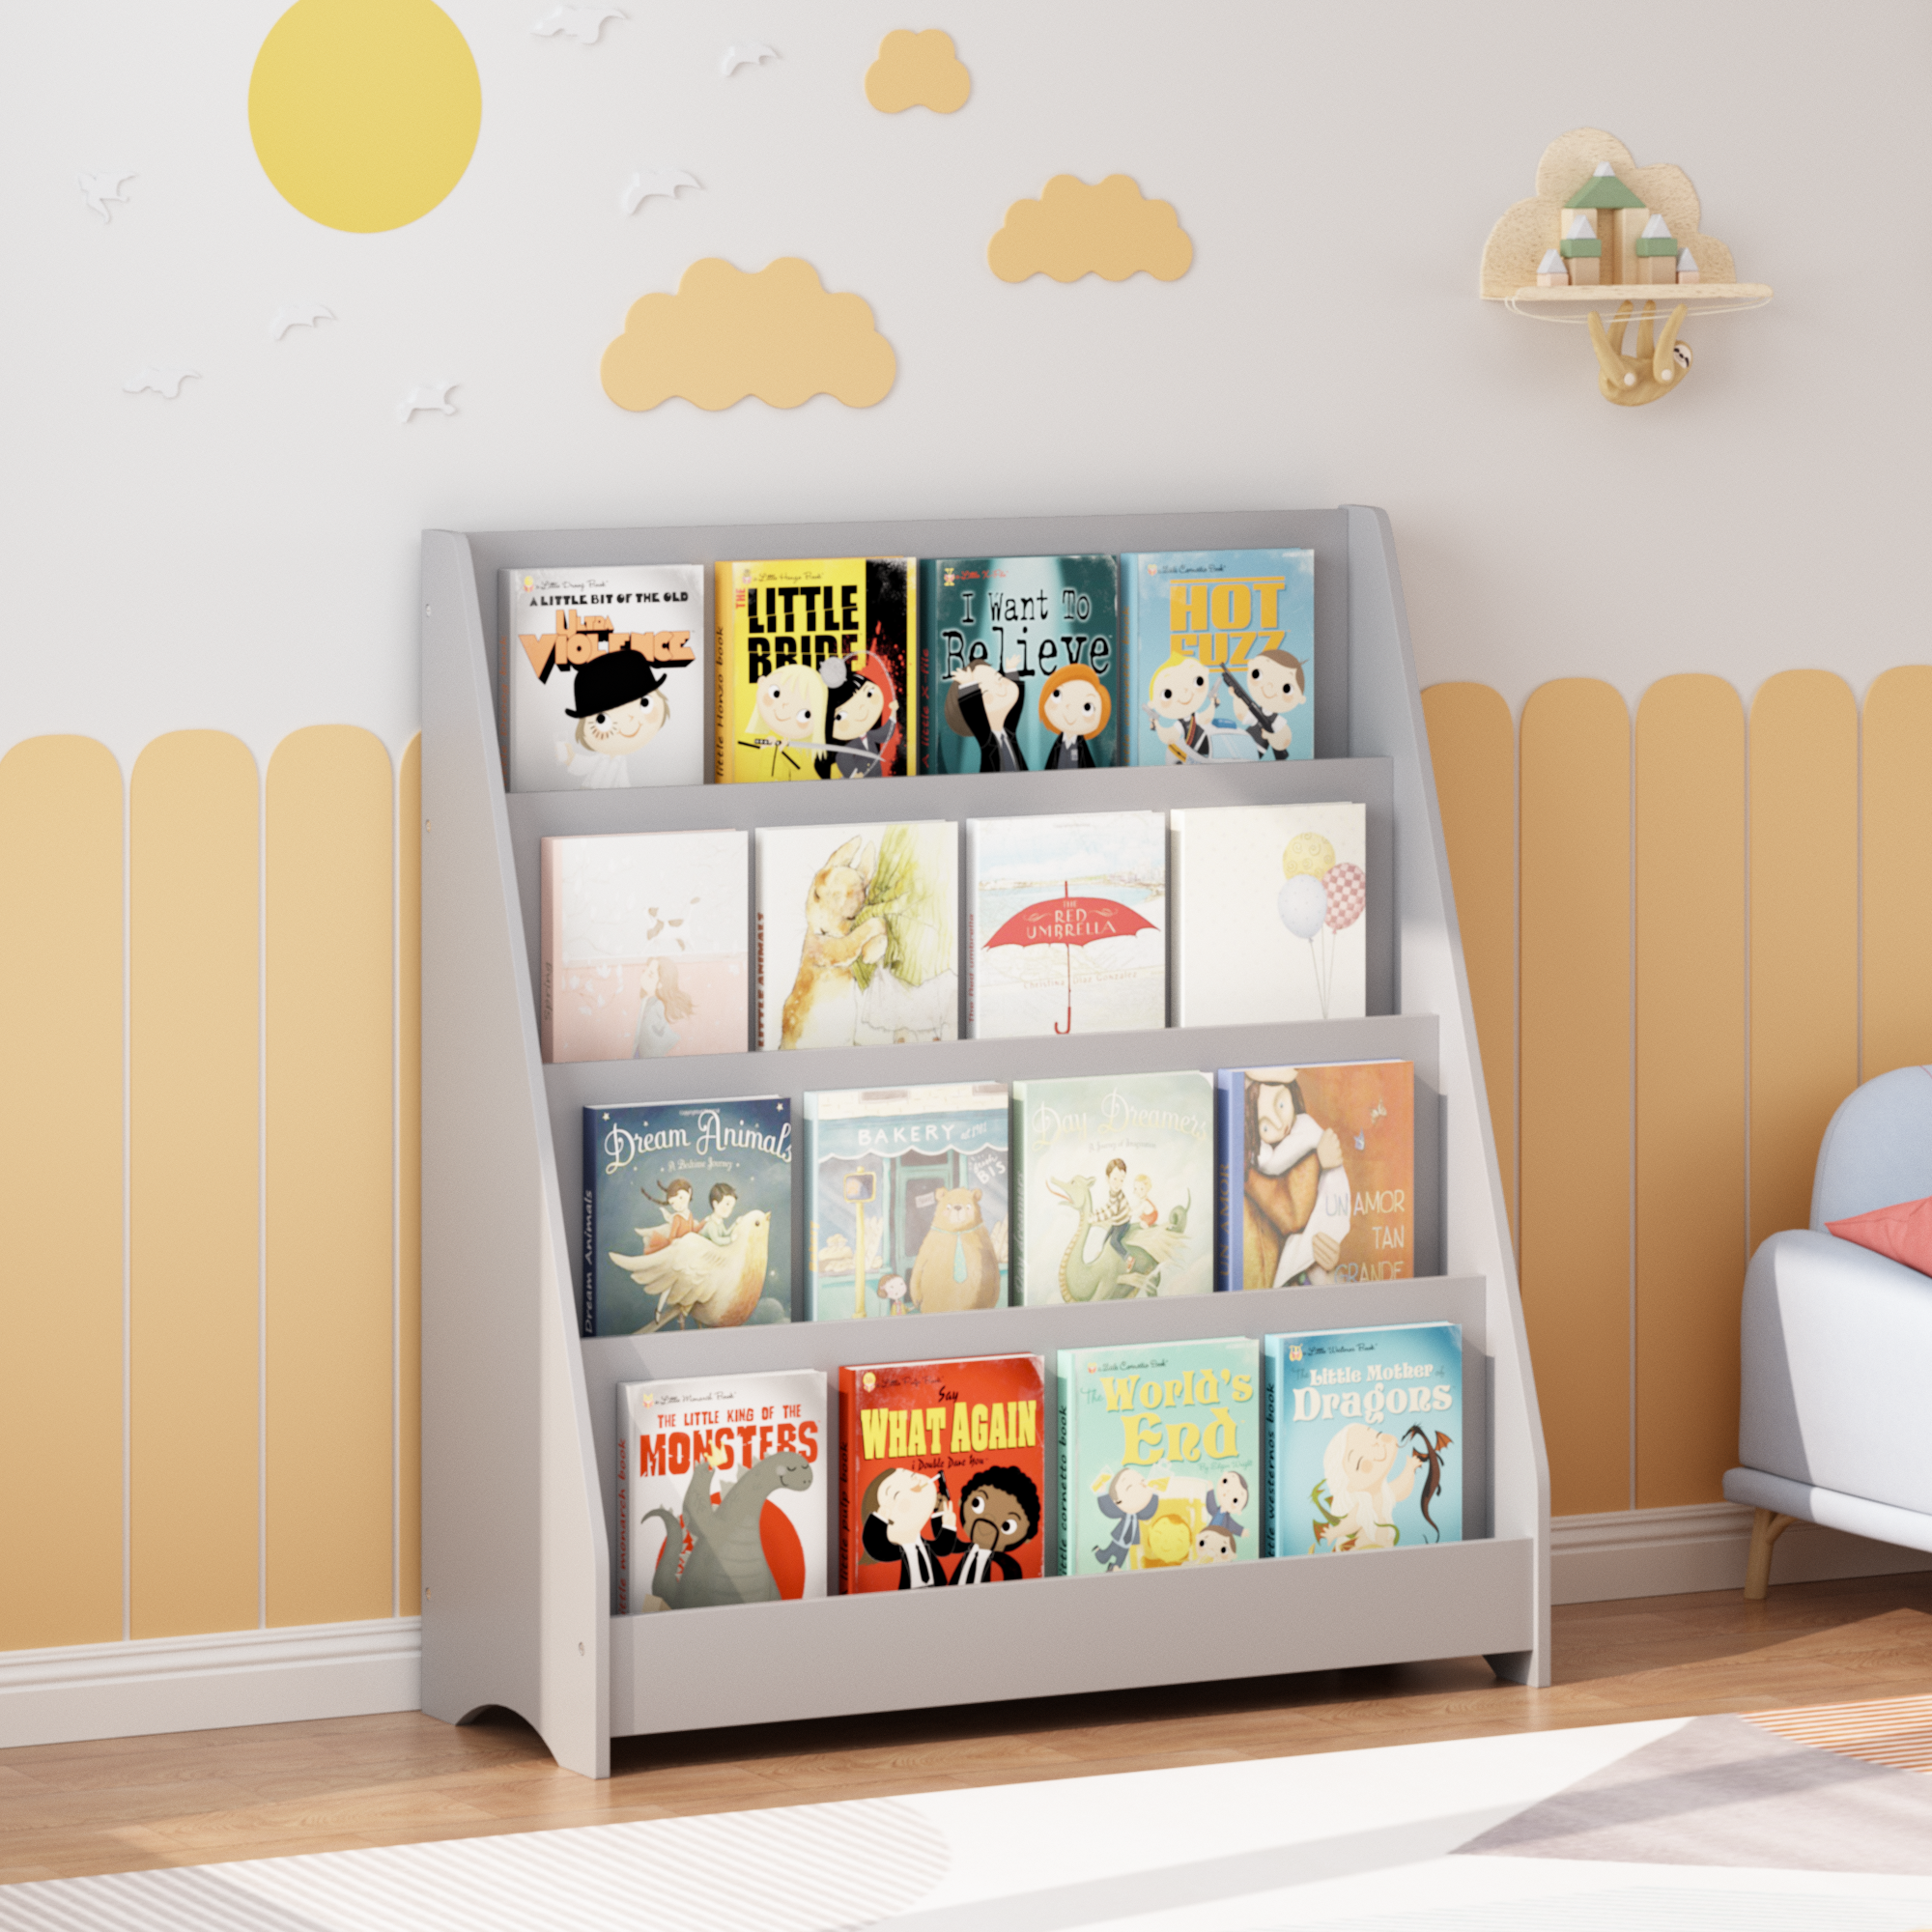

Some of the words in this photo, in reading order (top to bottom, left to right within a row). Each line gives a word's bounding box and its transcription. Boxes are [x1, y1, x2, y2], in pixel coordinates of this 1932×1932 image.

[529, 597, 538, 607] A
[540, 595, 587, 607] LITTLE
[591, 594, 613, 605] BIT
[616, 593, 633, 604] OF
[636, 592, 660, 603] THE
[664, 591, 689, 603] OLD
[735, 587, 746, 609] THE
[748, 585, 859, 634] LITTLE
[962, 592, 974, 623] I
[988, 589, 1048, 621] Want
[1063, 589, 1091, 620] To
[1170, 582, 1286, 632] HOT
[498, 636, 508, 675] book
[716, 626, 724, 666] book
[942, 626, 1109, 680] Believe
[1170, 631, 1286, 667] FUZZ
[921, 705, 930, 747] little
[716, 736, 724, 777] little
[921, 753, 930, 768] A
[1055, 908, 1088, 923] RED
[1063, 899, 1077, 909] THE
[756, 912, 765, 986] ANIMALS
[1026, 921, 1117, 940] UMBRELLA
[756, 990, 765, 1048] LITTLE
[858, 1123, 955, 1147] BAKERY
[1032, 1100, 1088, 1152] Day
[1096, 1086, 1207, 1141] Dreamers
[604, 1122, 691, 1175] Dream
[696, 1109, 792, 1163] Animals
[1219, 1163, 1230, 1235] AMOR
[1325, 1192, 1349, 1216] UN
[1353, 1189, 1406, 1216] AMOR
[583, 1189, 593, 1264] Animals
[1372, 1225, 1405, 1250] TAN
[1219, 1243, 1230, 1276] UN
[1334, 1260, 1405, 1284] GRANDE
[583, 1272, 593, 1333] Dream
[938, 1385, 959, 1404] Say
[1080, 1387, 1104, 1405] The
[1099, 1368, 1254, 1412] World's
[1291, 1366, 1310, 1380] The
[1309, 1366, 1362, 1386] Little
[1366, 1362, 1434, 1382] Mother
[657, 1413, 676, 1429] THE
[684, 1410, 720, 1426] LITTLE
[726, 1407, 754, 1423] KING
[761, 1406, 775, 1420] OF
[782, 1404, 802, 1419] THE
[1293, 1382, 1452, 1424] Dragons
[861, 1406, 947, 1461] WHAT
[950, 1400, 1037, 1454] AGAIN
[1059, 1405, 1067, 1446] book
[1121, 1406, 1239, 1466] End
[618, 1438, 627, 1481] book
[639, 1420, 819, 1478] MONSTERS
[839, 1441, 848, 1483] book
[918, 1458, 945, 1470] Double
[948, 1456, 966, 1468] Dare
[839, 1492, 850, 1532] pulp
[1059, 1455, 1067, 1531] cornetto
[618, 1489, 627, 1570] monarch
